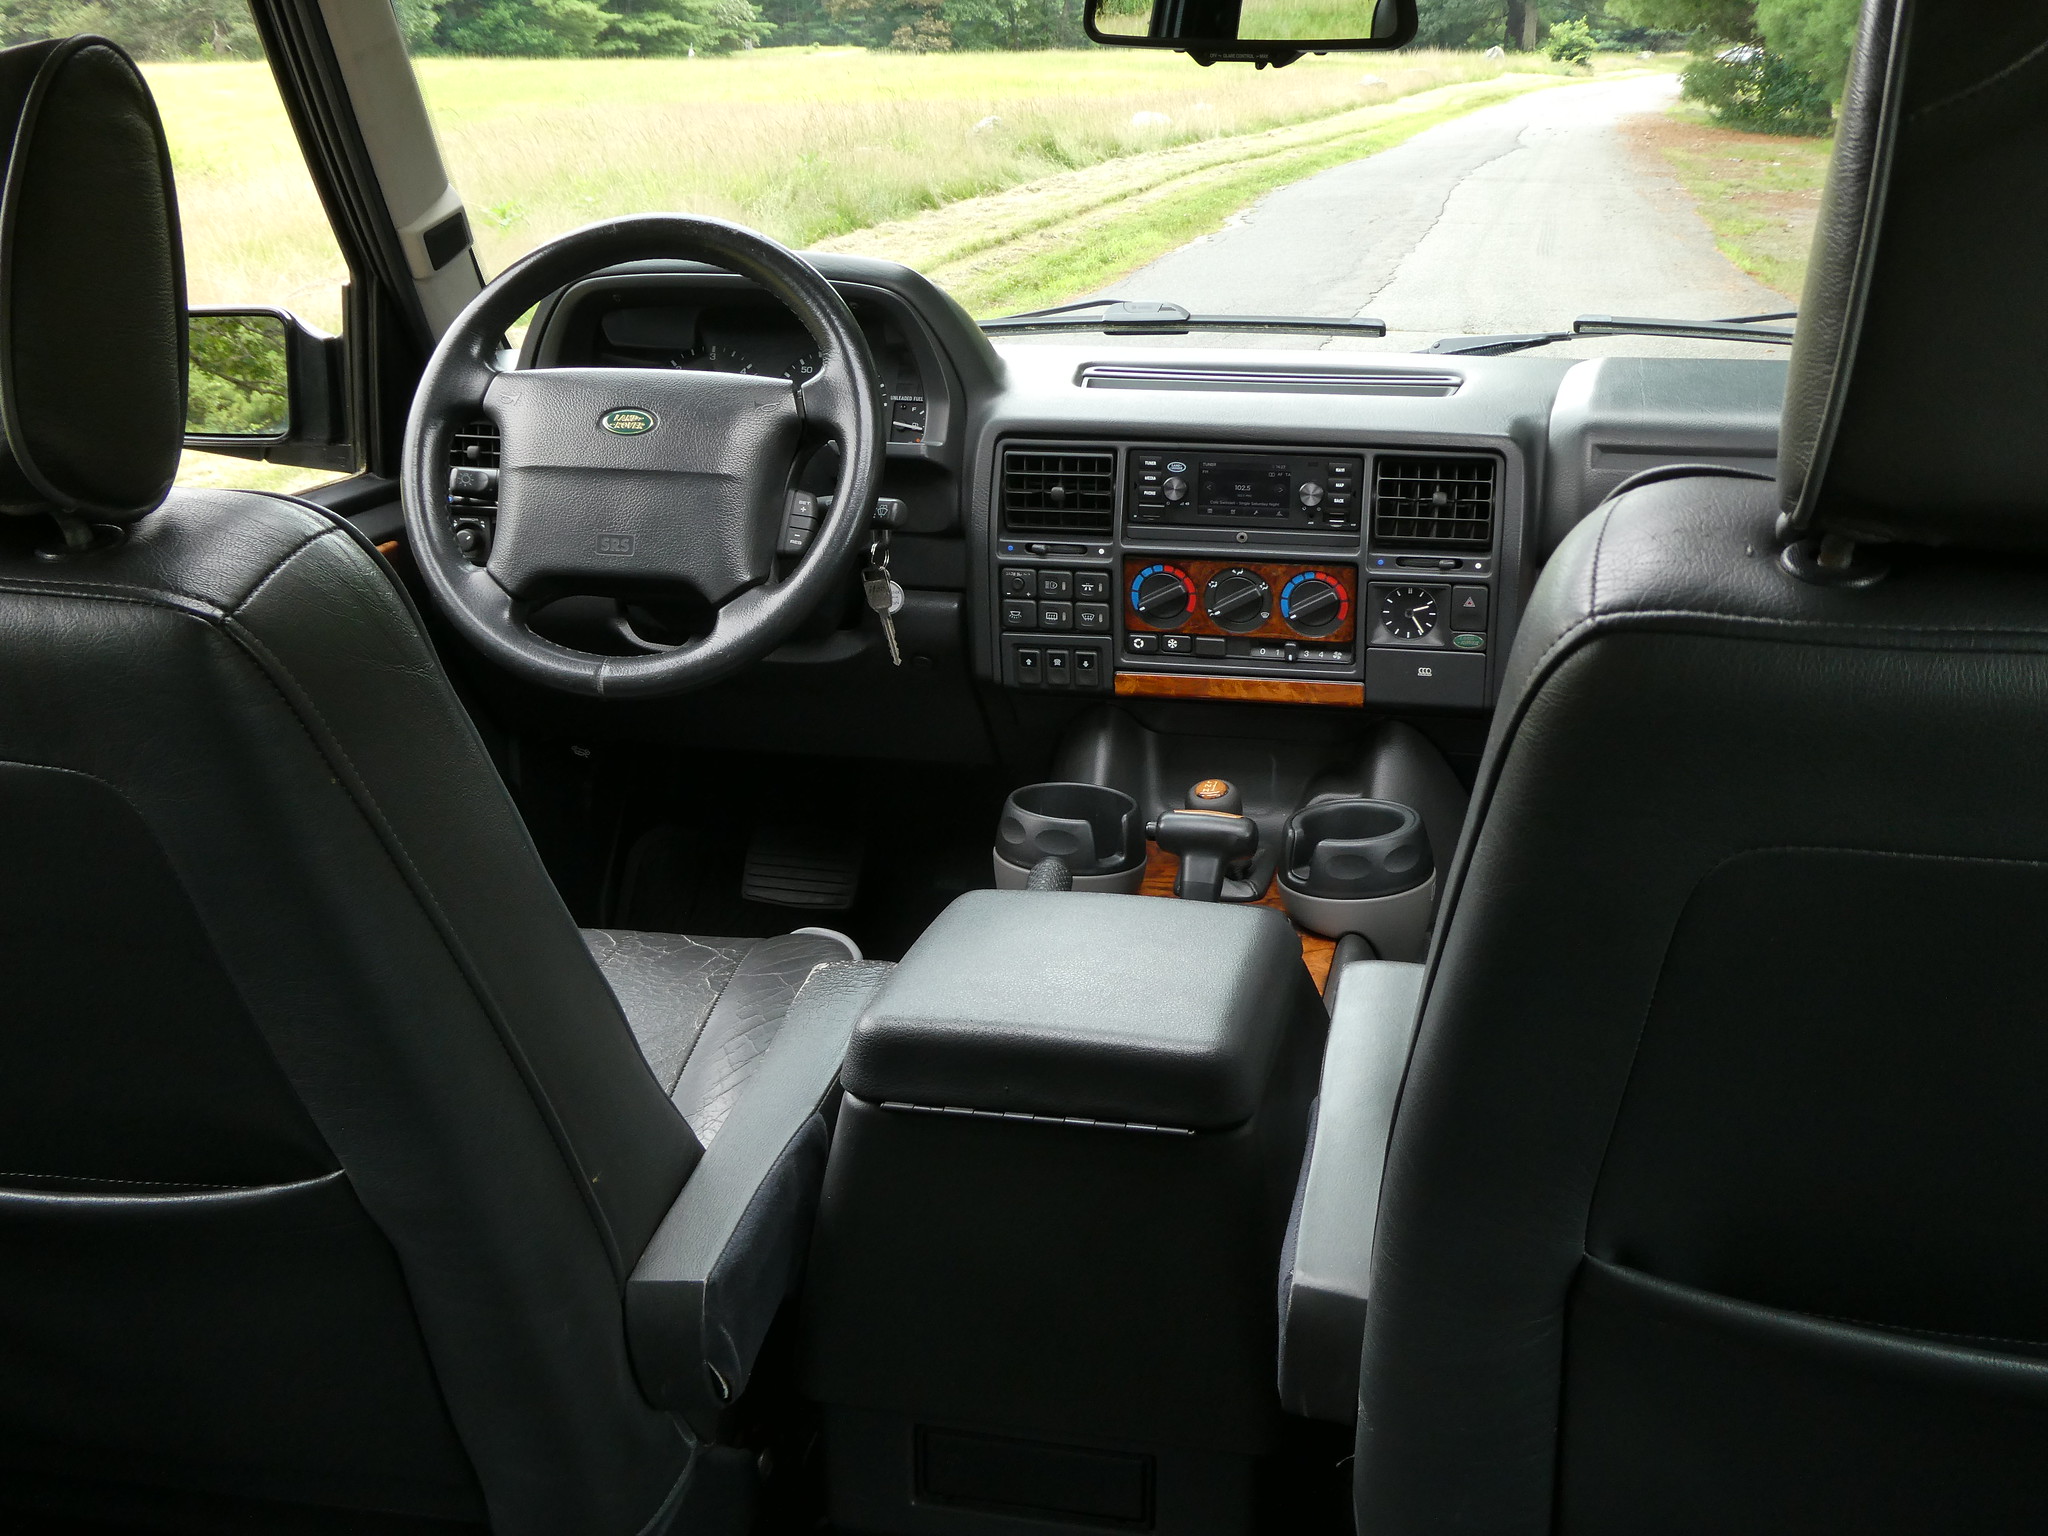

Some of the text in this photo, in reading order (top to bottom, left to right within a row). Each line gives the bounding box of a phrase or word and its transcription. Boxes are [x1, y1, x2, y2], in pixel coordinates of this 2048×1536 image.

[739, 367, 746, 375] 4
[800, 366, 813, 374] 50
[613, 421, 645, 430] ROVER
[601, 537, 630, 552] SRS
